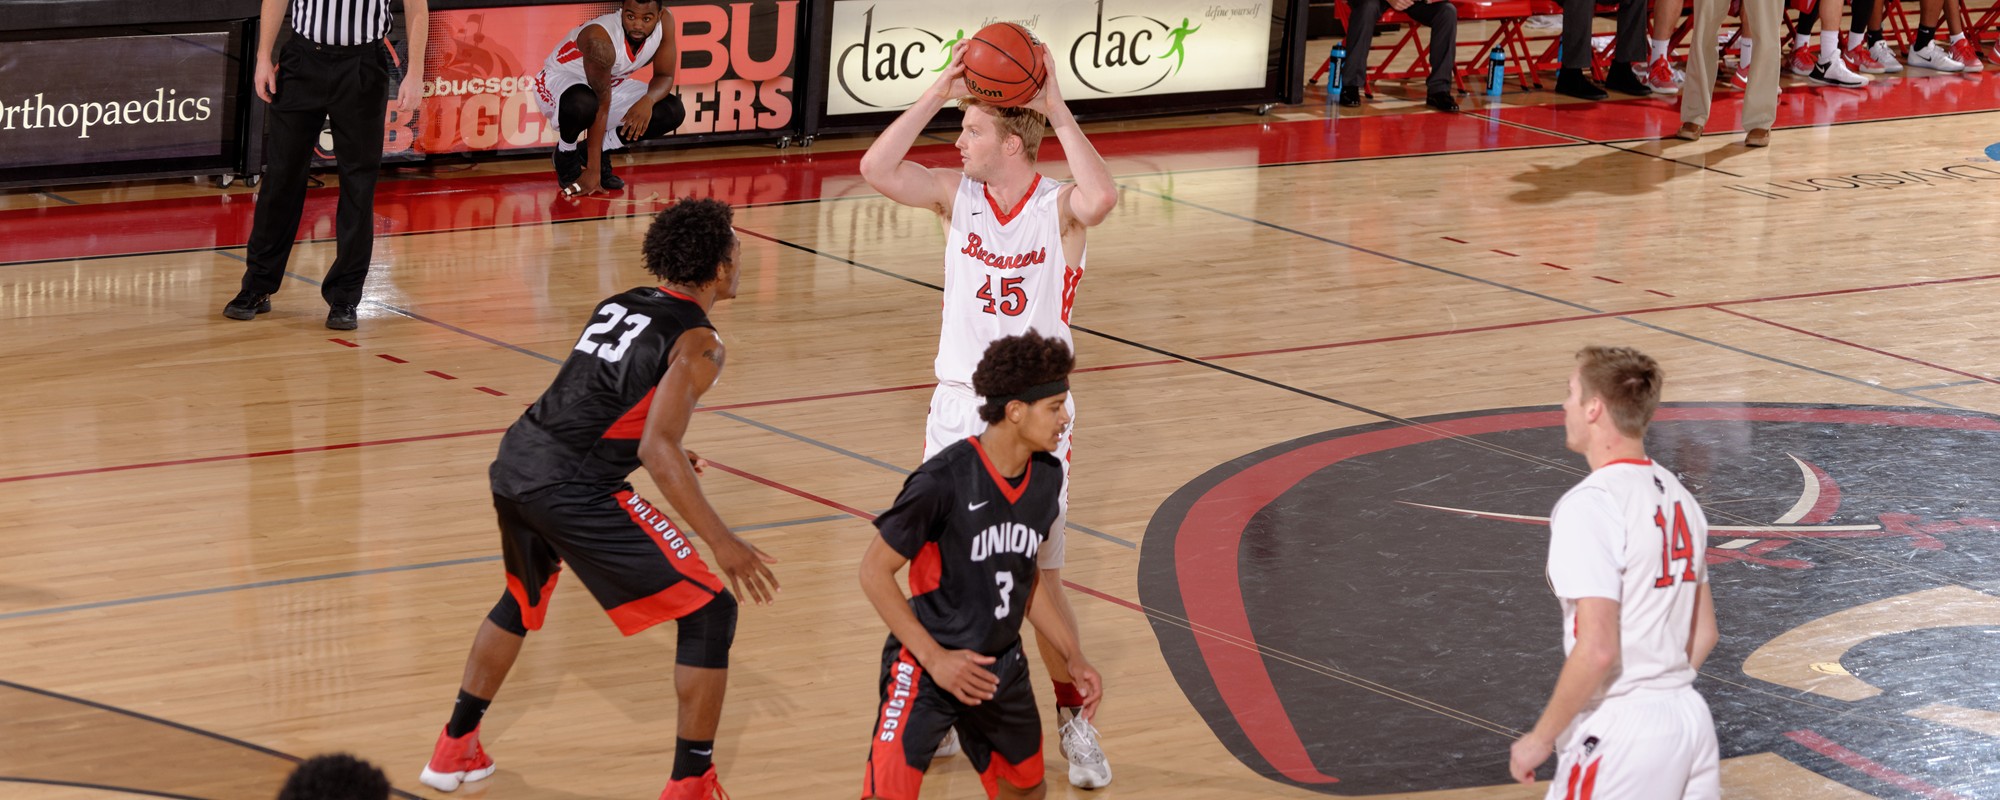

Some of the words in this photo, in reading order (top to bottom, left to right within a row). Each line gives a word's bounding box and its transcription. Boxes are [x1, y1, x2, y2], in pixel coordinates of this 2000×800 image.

[1205, 5, 1229, 21] define
[1228, 3, 1262, 20] yourself
[666, 1, 799, 85] BU
[837, 4, 926, 107] dac
[1069, 0, 1153, 93] dac
[423, 76, 534, 97] obucsgo
[967, 78, 1003, 97] ilson
[0, 88, 211, 138] rthopaedics
[961, 232, 1046, 270] Buccaneers
[976, 274, 1028, 317] 45
[574, 302, 652, 363] 23
[626, 493, 692, 560] BULLDOGS
[970, 521, 1044, 562] UNION
[1653, 500, 1697, 589] 14
[994, 570, 1014, 620] 3
[880, 661, 915, 743] BULLDOGS
